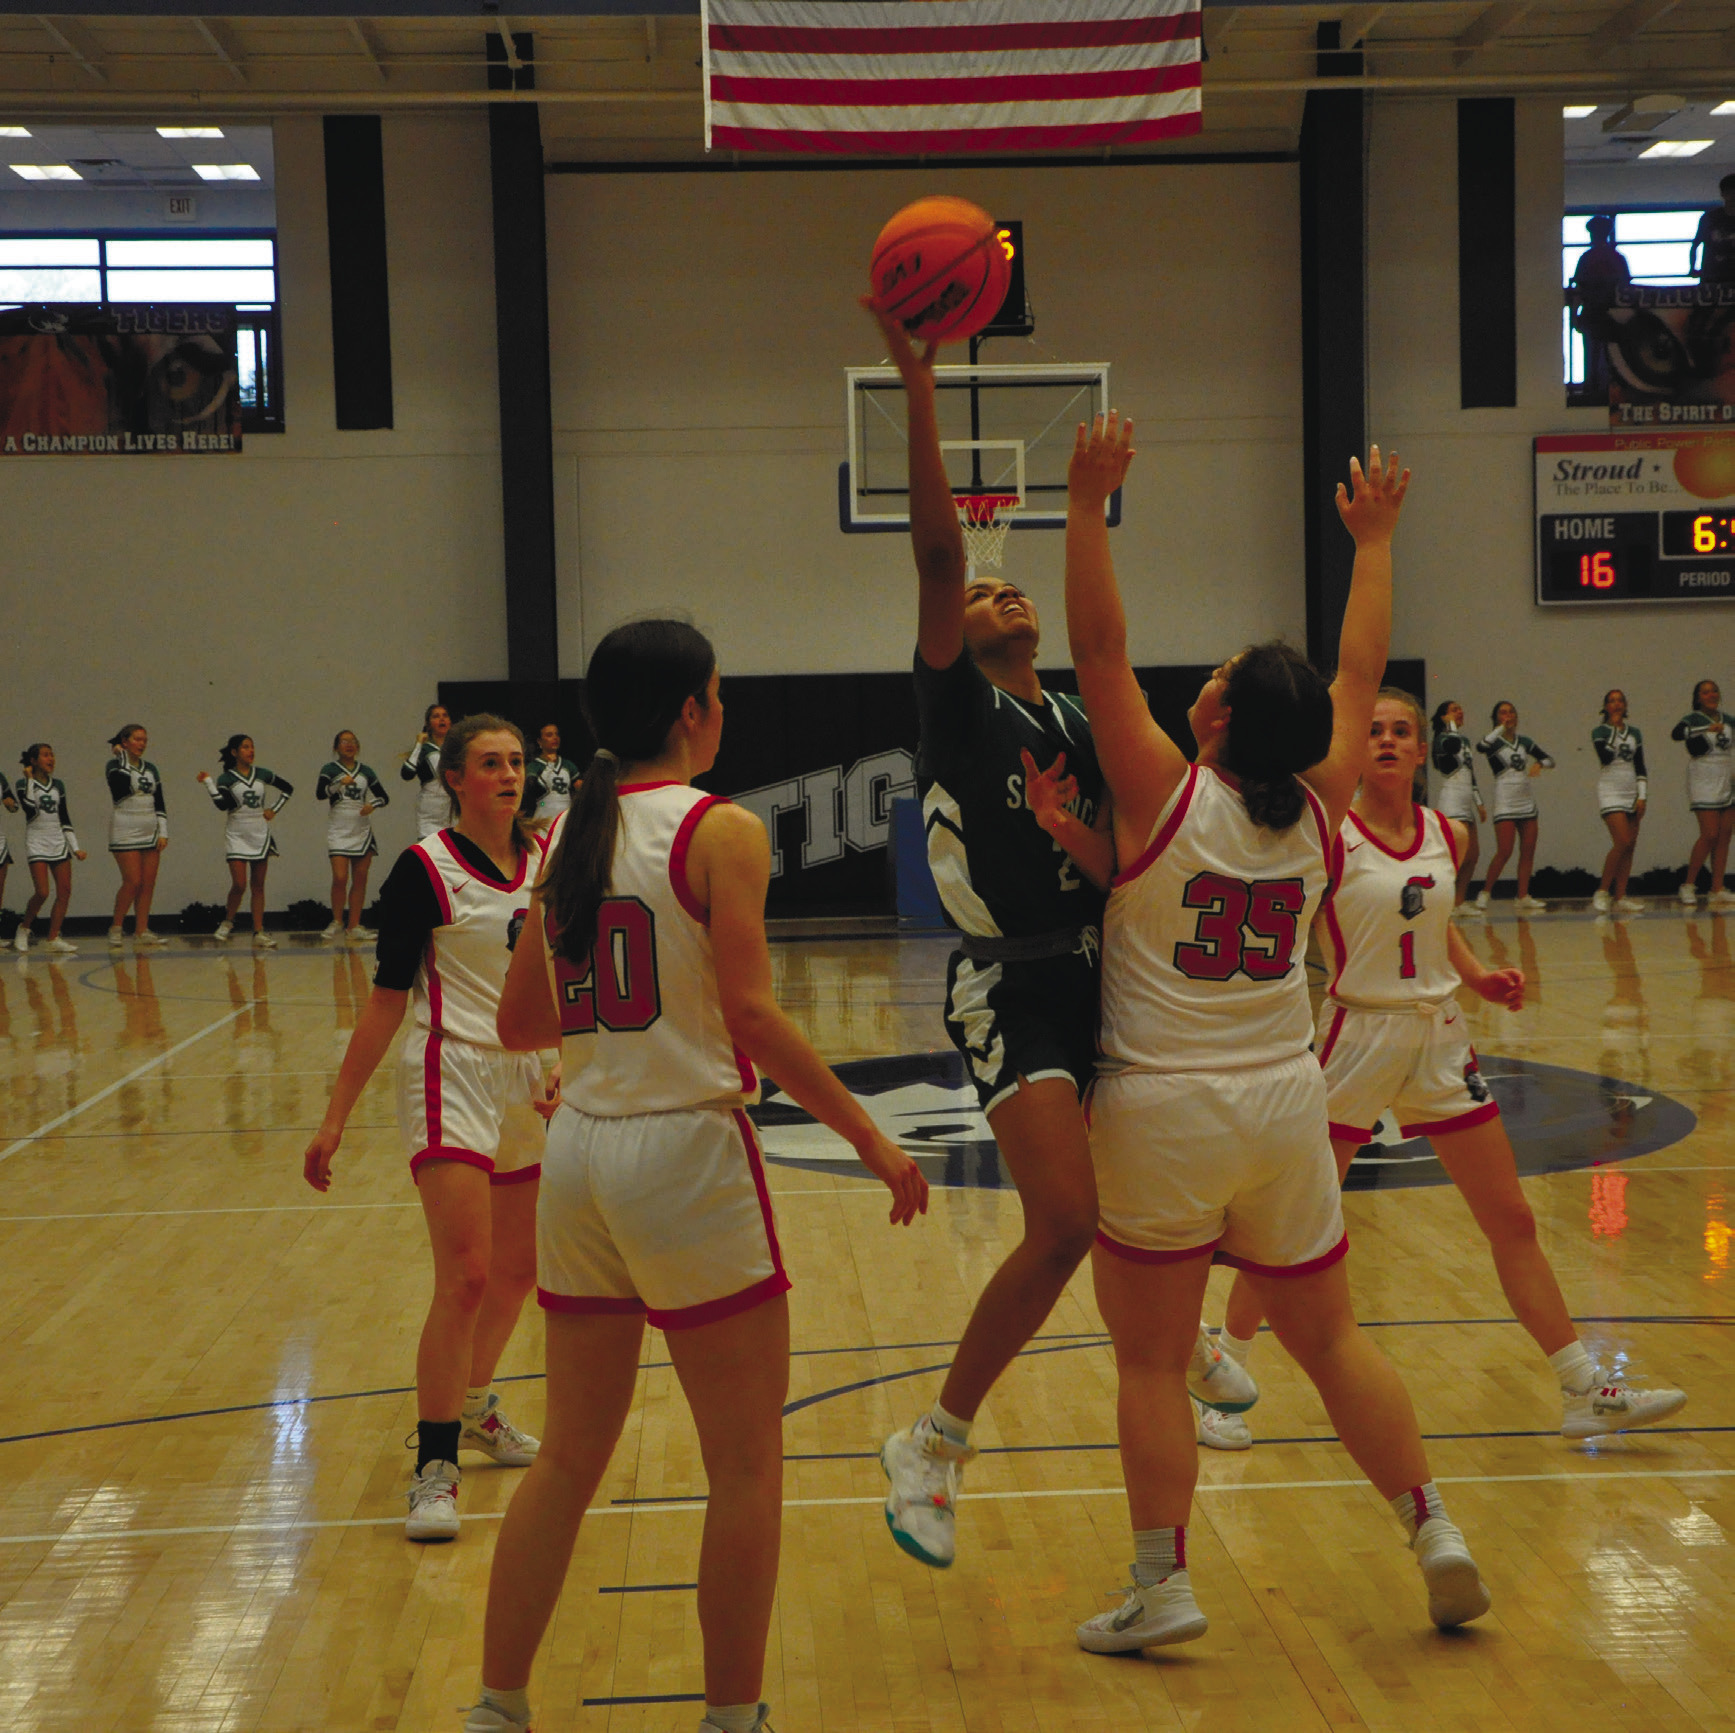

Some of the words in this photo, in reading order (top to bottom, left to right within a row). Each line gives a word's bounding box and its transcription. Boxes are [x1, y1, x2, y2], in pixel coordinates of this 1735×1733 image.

[169, 198, 190, 214] EXIT
[111, 308, 228, 333] TIGERS
[1619, 402, 1654, 422] THE
[1659, 398, 1717, 421] SPIRIT
[5, 436, 17, 451] A
[22, 432, 119, 451] CHAMPION
[124, 431, 178, 451] LIVES
[182, 431, 235, 451] HERE!
[1553, 457, 1643, 481] Stroud
[1555, 484, 1580, 496] The
[1584, 481, 1621, 495] Place
[1628, 481, 1645, 494] To
[1553, 518, 1616, 540] HOME
[1580, 551, 1616, 589] 16
[1679, 571, 1731, 587] PERIOD
[1173, 871, 1305, 982] 35
[1399, 931, 1415, 979] 1
